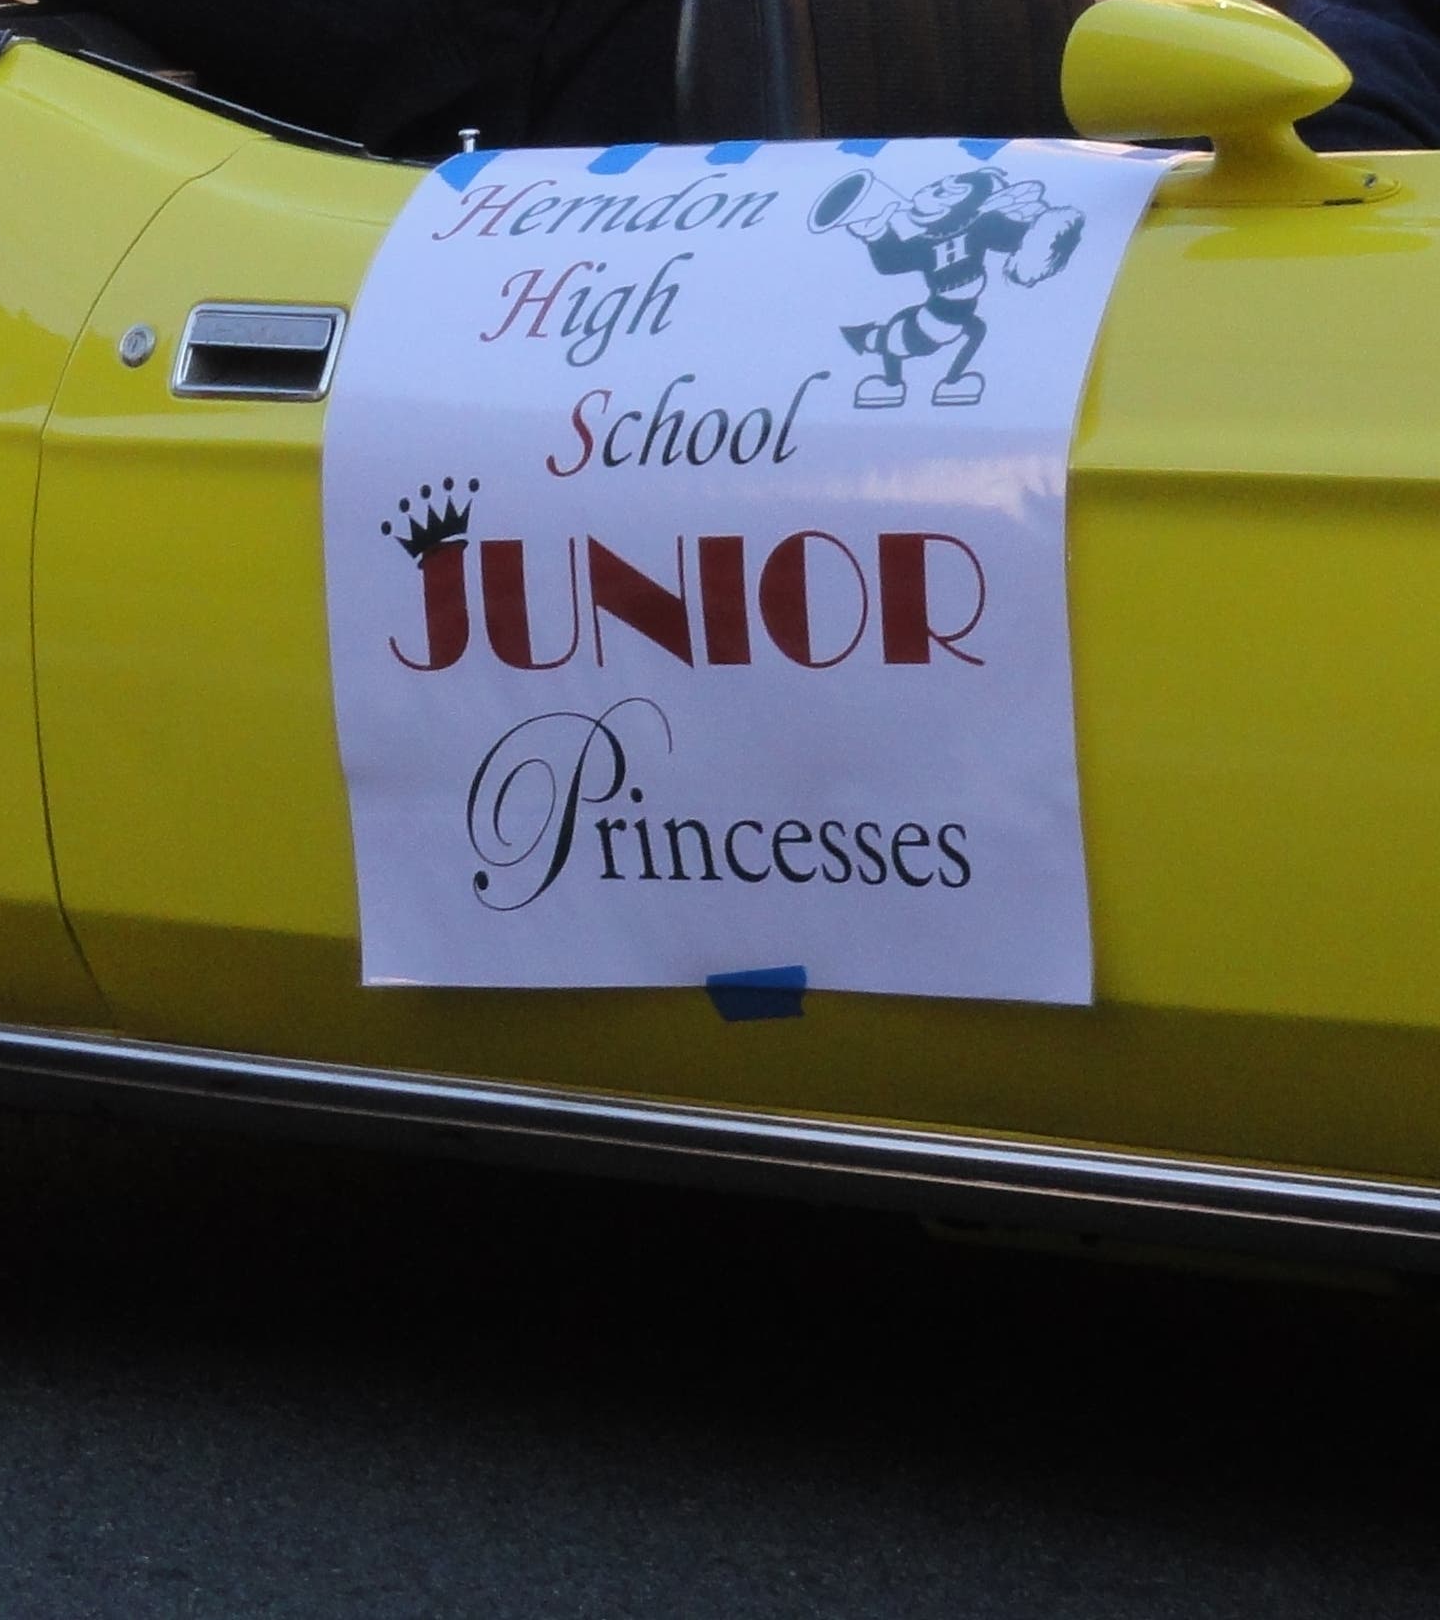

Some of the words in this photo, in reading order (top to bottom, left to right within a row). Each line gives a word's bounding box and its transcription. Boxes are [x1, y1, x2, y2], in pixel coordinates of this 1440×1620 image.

[431, 173, 779, 242] Herndon
[931, 233, 971, 273] H
[479, 252, 694, 366] High
[545, 371, 831, 478] School
[388, 530, 987, 672] JUNIOR
[465, 697, 973, 913] Princesses
